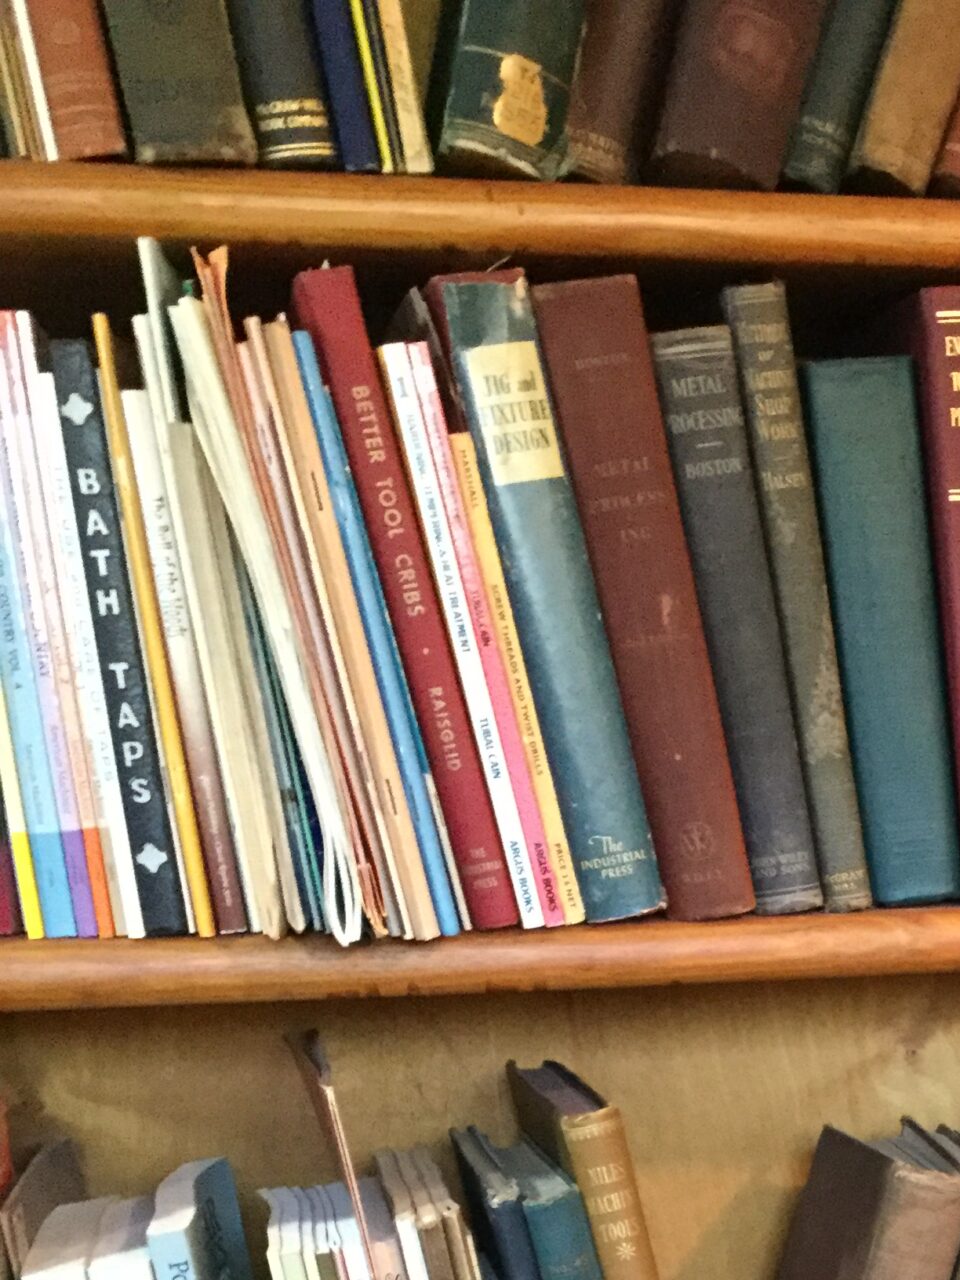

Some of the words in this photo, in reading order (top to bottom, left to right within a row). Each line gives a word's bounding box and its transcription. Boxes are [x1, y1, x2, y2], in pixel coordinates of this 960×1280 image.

[483, 374, 512, 398] JIG
[670, 373, 727, 399] METAL
[479, 399, 550, 427] FIXTURE
[493, 427, 551, 456] DESIGN
[352, 385, 387, 464] BETTER
[375, 477, 405, 540] TOOL
[394, 554, 426, 618] CRIBS
[76, 467, 121, 616] BATH
[108, 661, 152, 804] TAPS
[588, 835, 624, 854] The
[580, 848, 648, 872] INDUSTRIAL
[601, 864, 634, 880] PRESS
